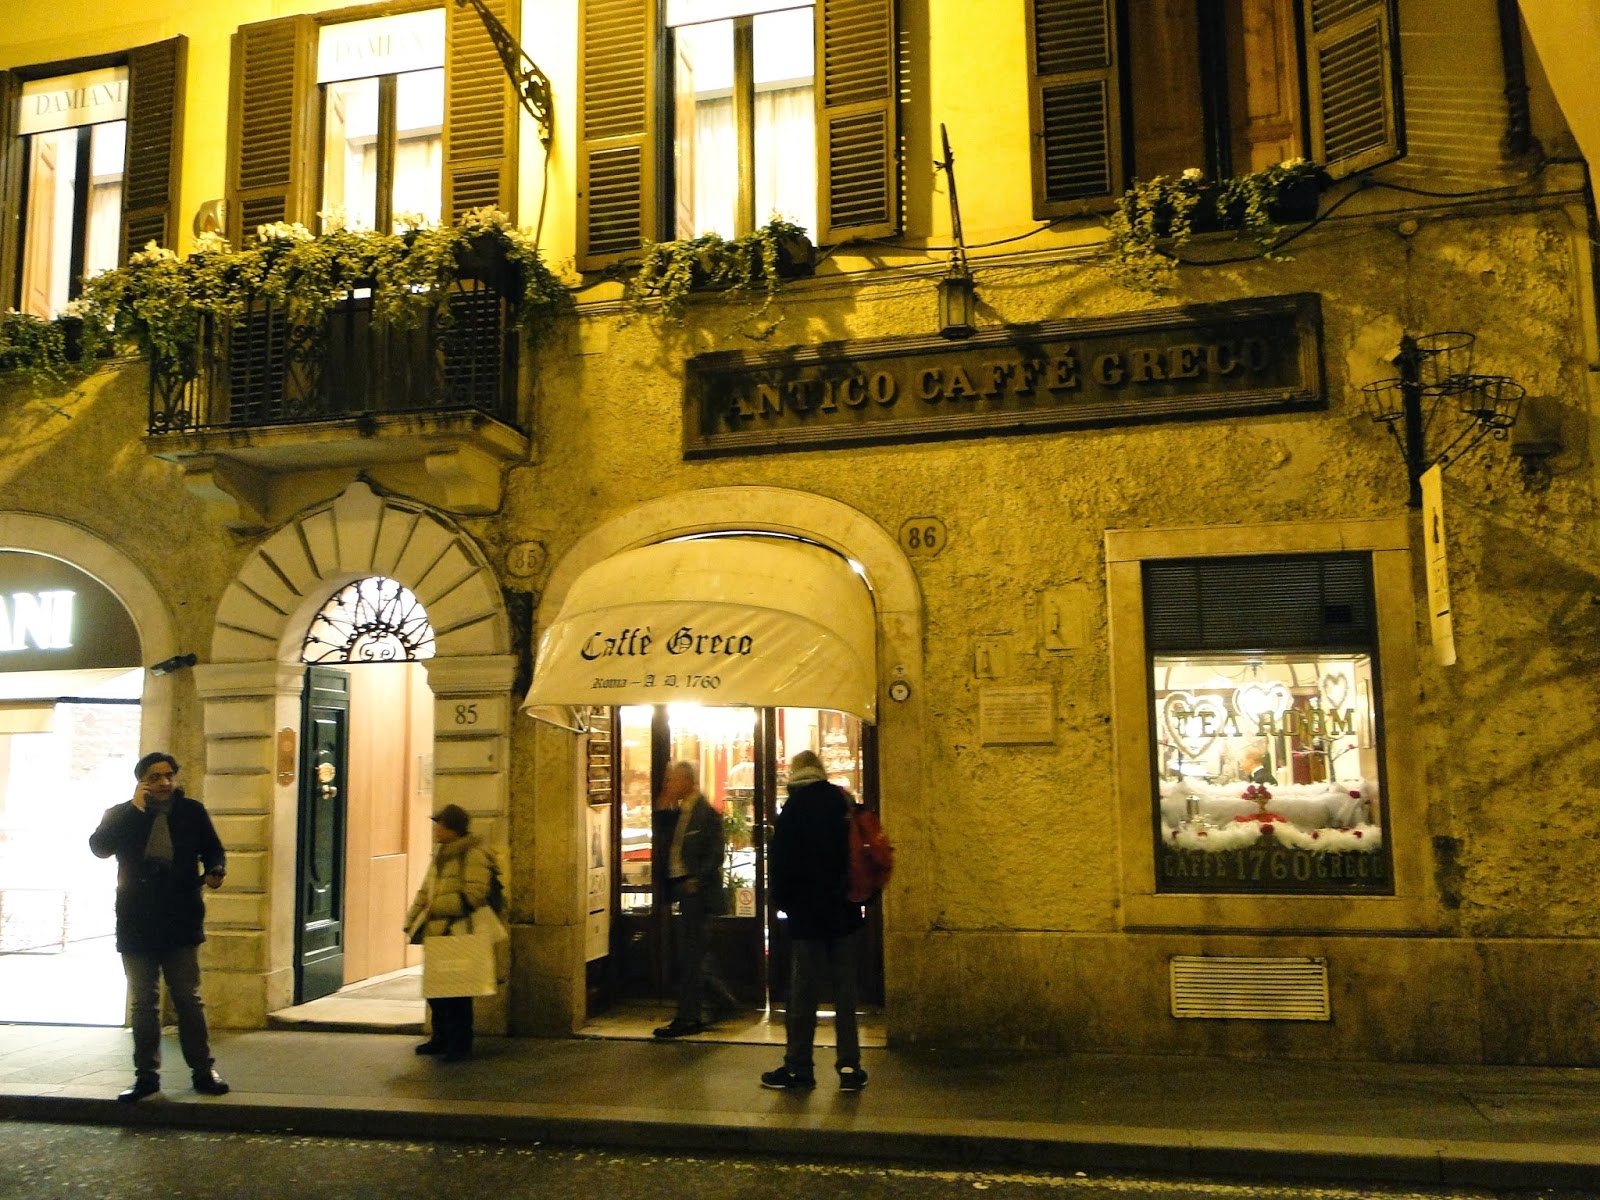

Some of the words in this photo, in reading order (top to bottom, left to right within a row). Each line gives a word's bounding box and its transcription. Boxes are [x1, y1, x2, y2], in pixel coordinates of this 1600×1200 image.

[35, 81, 124, 115] DAMIANI
[723, 370, 896, 419] ANTICO
[1092, 336, 1269, 386] GRECO
[908, 525, 936, 549] 86
[581, 626, 652, 660] Caffè
[666, 626, 753, 656] Greco
[591, 677, 627, 690] Roma
[686, 674, 721, 689] 1760
[455, 703, 479, 725] 85
[1173, 710, 1242, 737] TEA
[1256, 708, 1356, 736] ROOM
[1235, 850, 1312, 881] 1760
